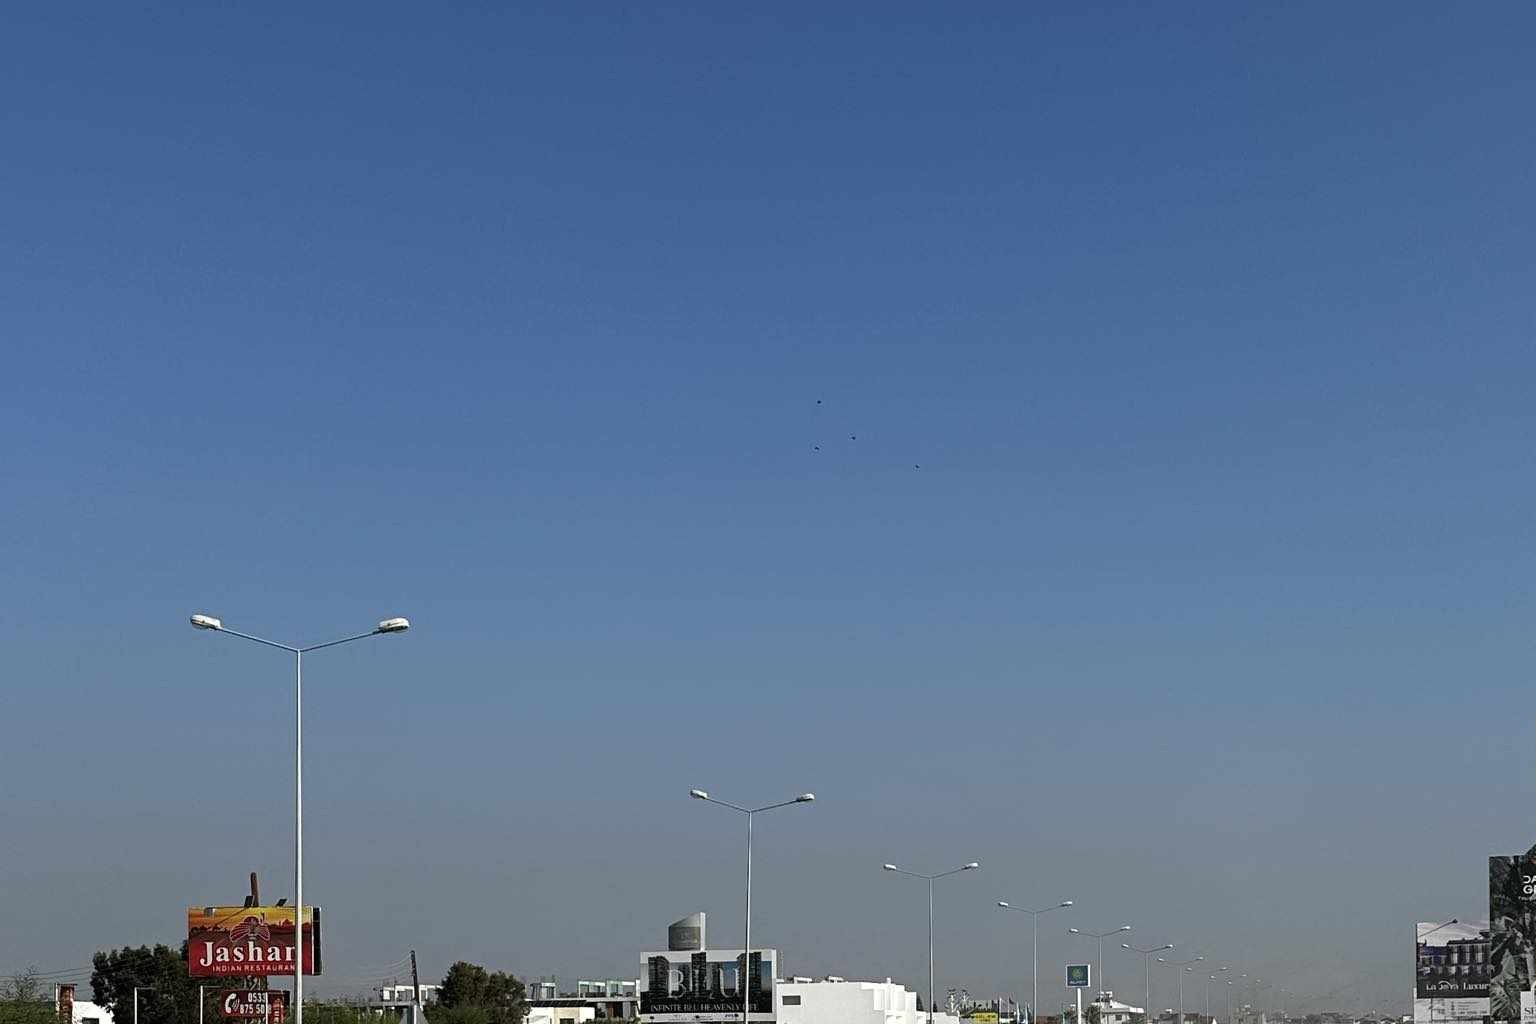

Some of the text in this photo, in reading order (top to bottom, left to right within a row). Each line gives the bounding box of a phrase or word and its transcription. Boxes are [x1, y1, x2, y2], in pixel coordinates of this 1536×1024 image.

[199, 941, 296, 967] Jashar
[212, 964, 296, 973] INDIAN RESTAURAN
[666, 967, 741, 1000] BLU
[247, 992, 266, 1003] 0533
[650, 1003, 682, 1013] INFINITE
[700, 1003, 740, 1013] HEAVENLY
